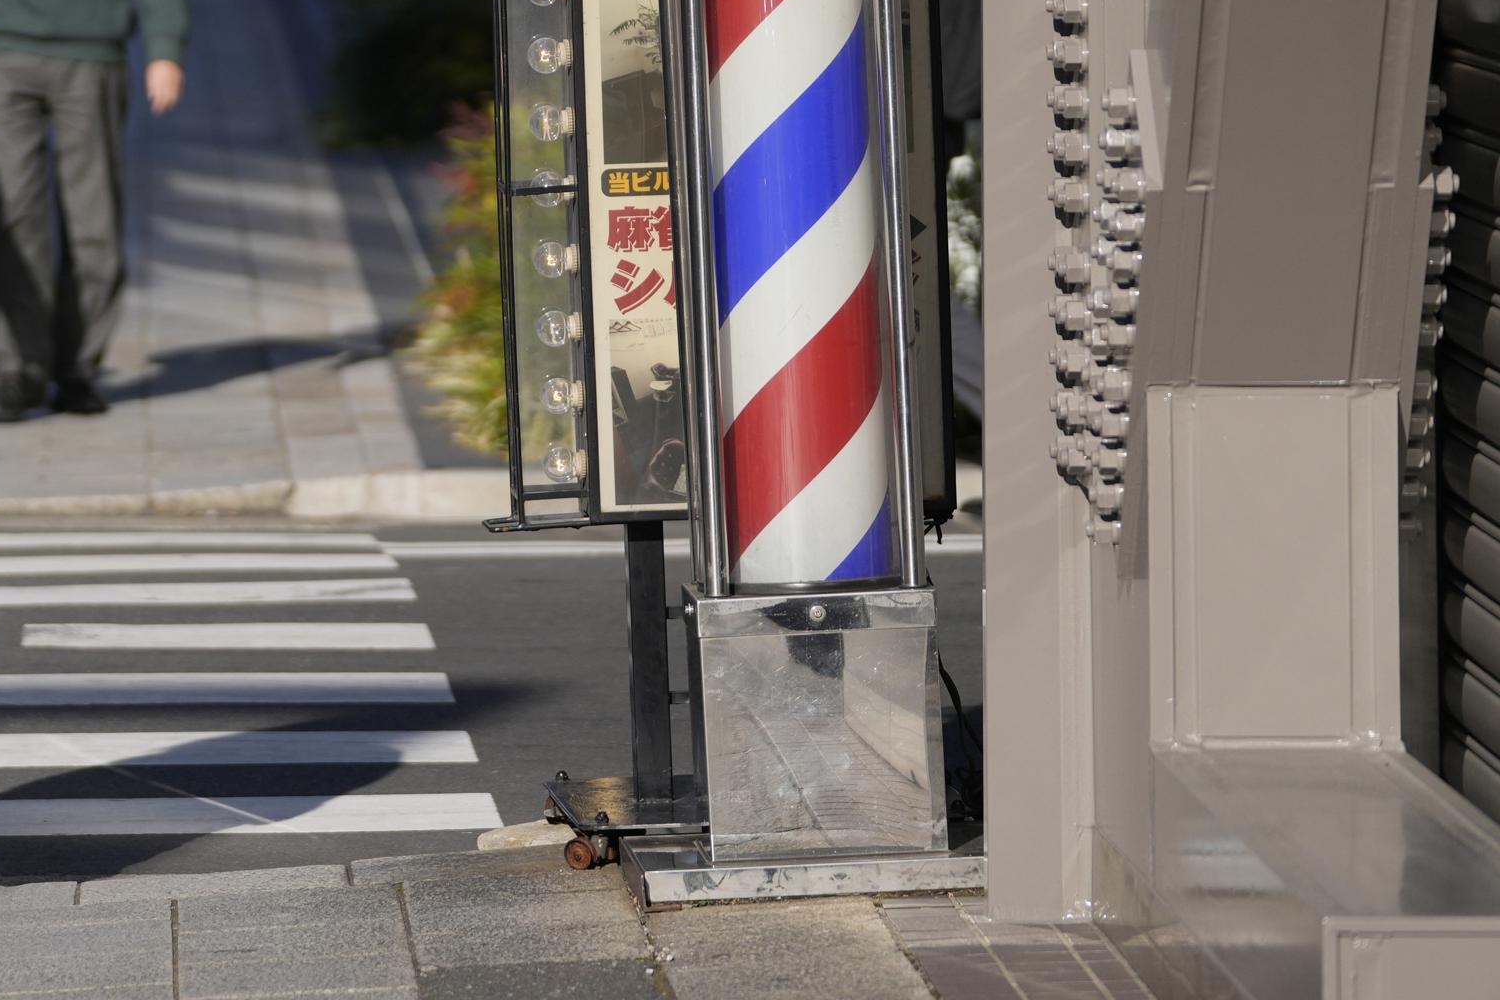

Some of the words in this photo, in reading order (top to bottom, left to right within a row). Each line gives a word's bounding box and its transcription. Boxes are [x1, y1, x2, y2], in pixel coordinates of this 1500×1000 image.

[608, 170, 669, 194] 当ビル
[610, 259, 676, 315] シ
